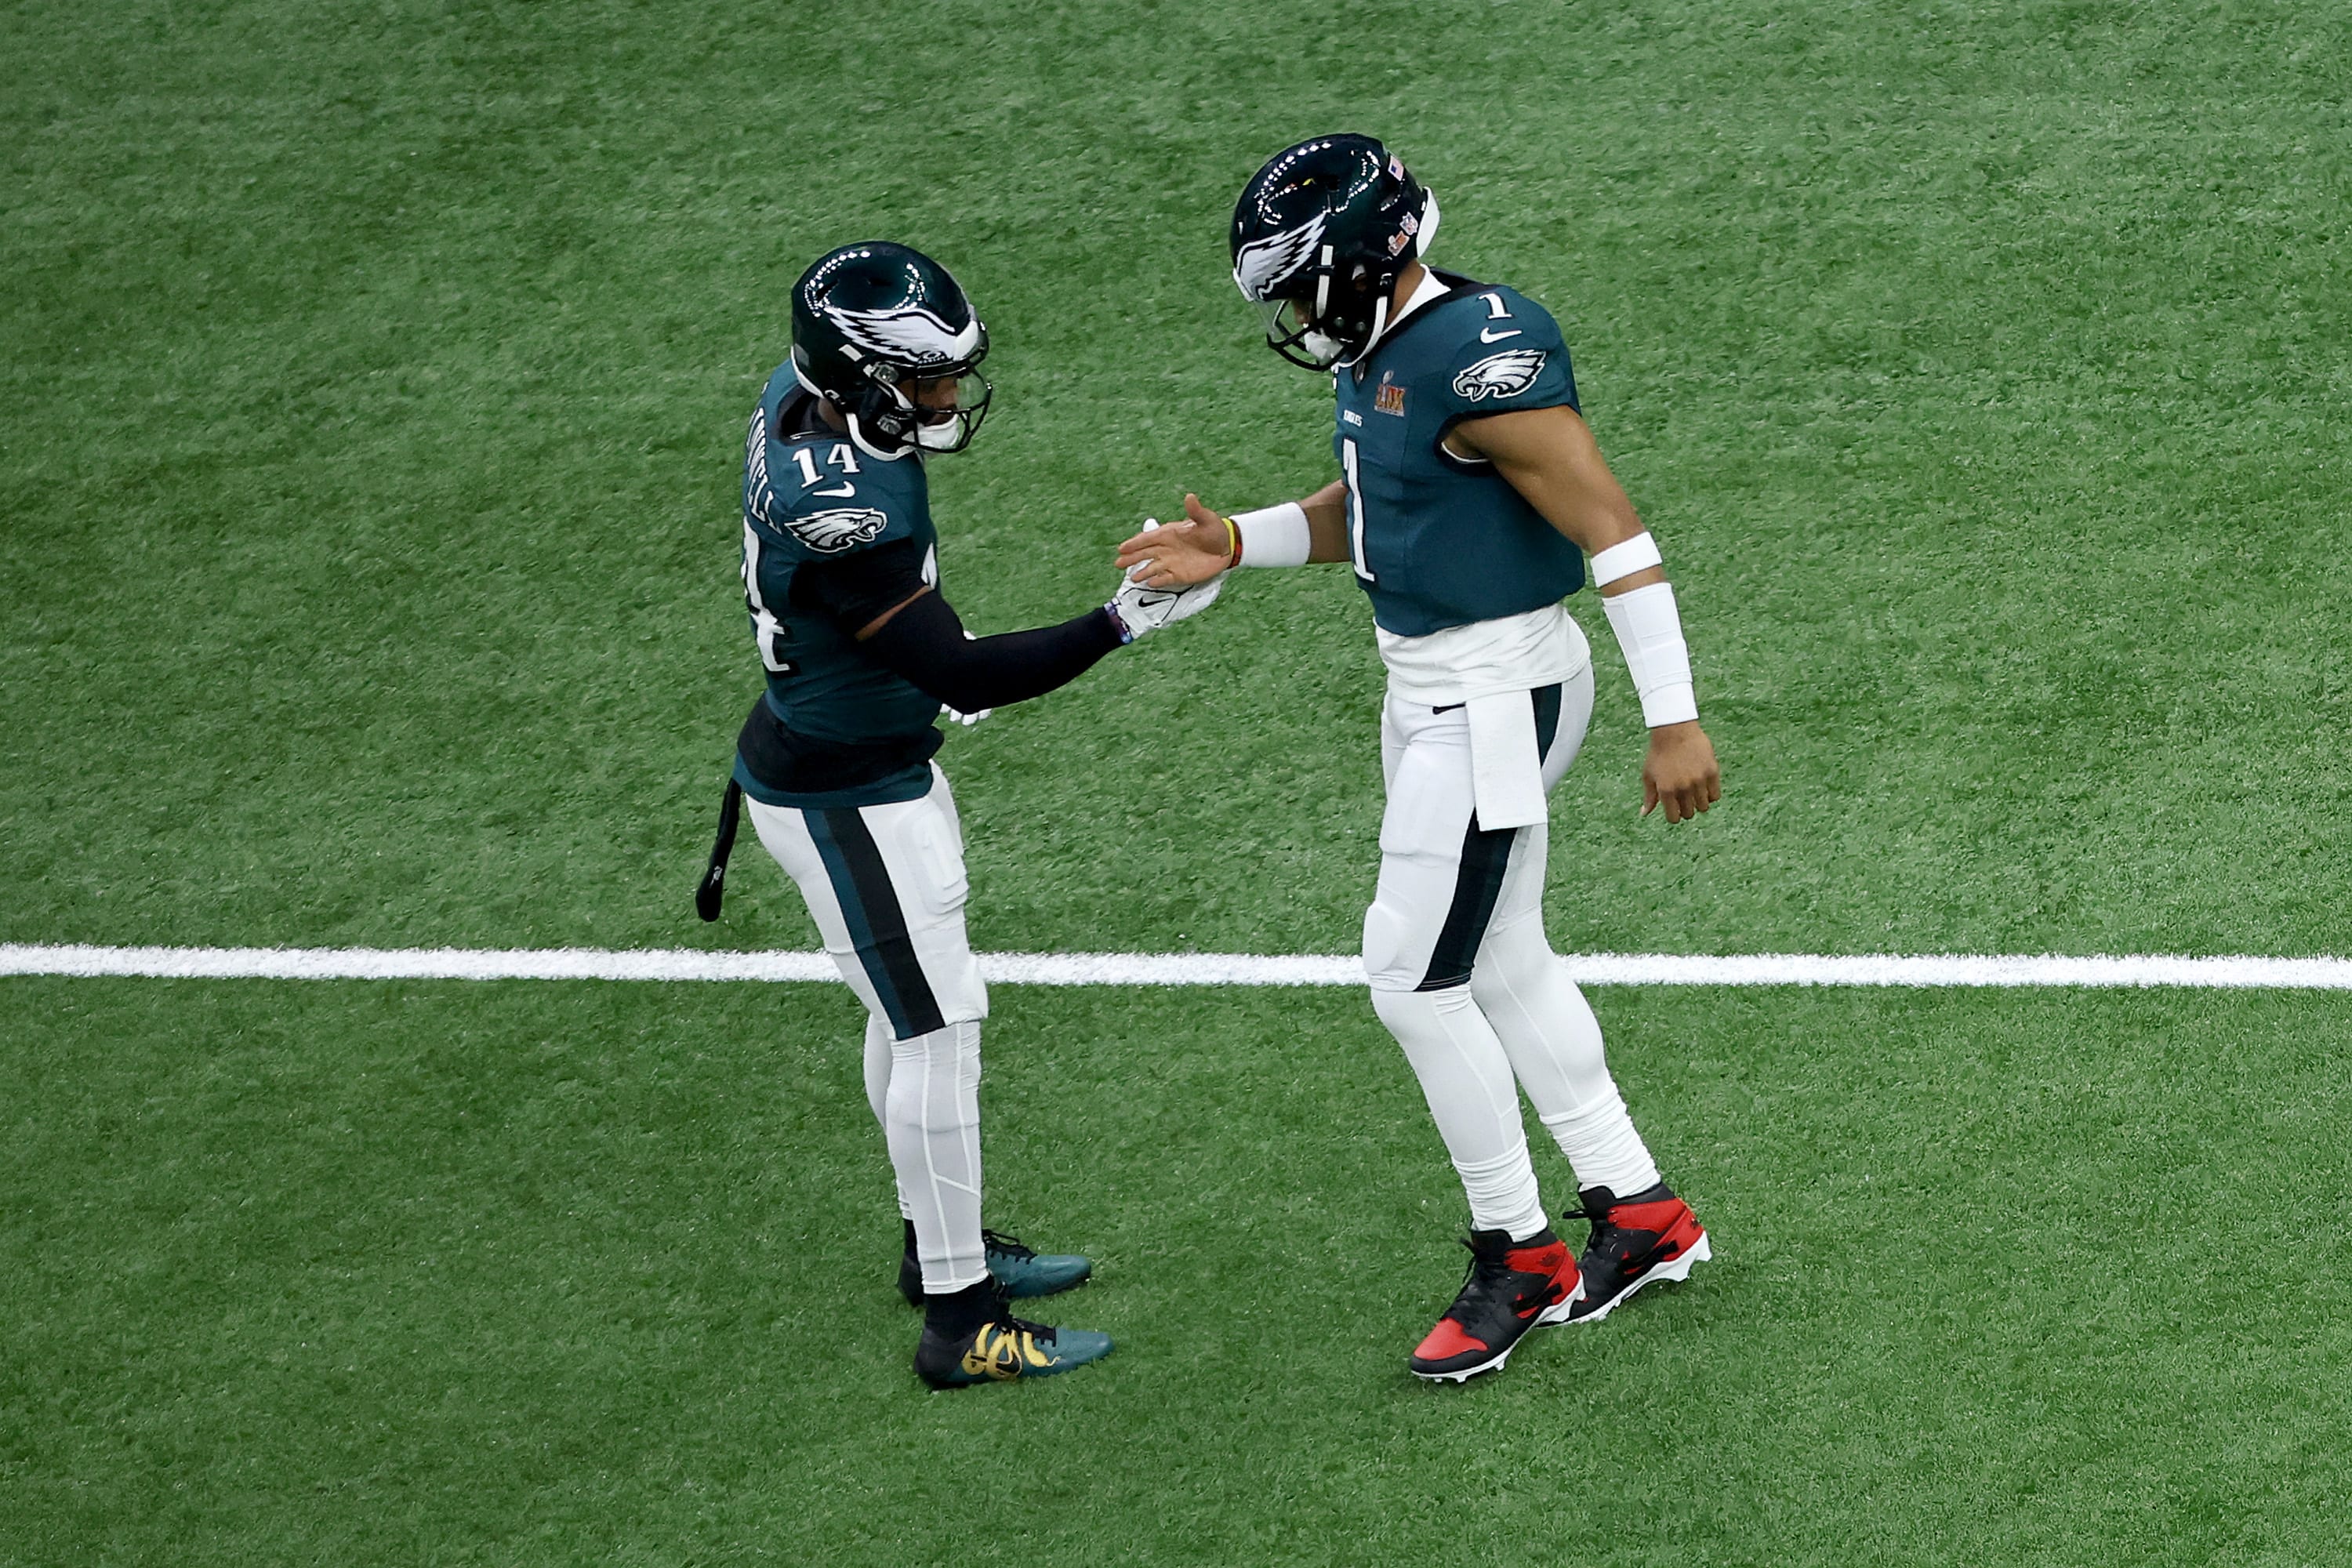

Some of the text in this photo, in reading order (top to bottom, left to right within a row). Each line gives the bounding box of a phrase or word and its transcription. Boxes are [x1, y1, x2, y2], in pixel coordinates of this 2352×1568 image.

[1479, 292, 1512, 320] 1
[792, 443, 861, 488] 14
[1343, 437, 1376, 583] 1
